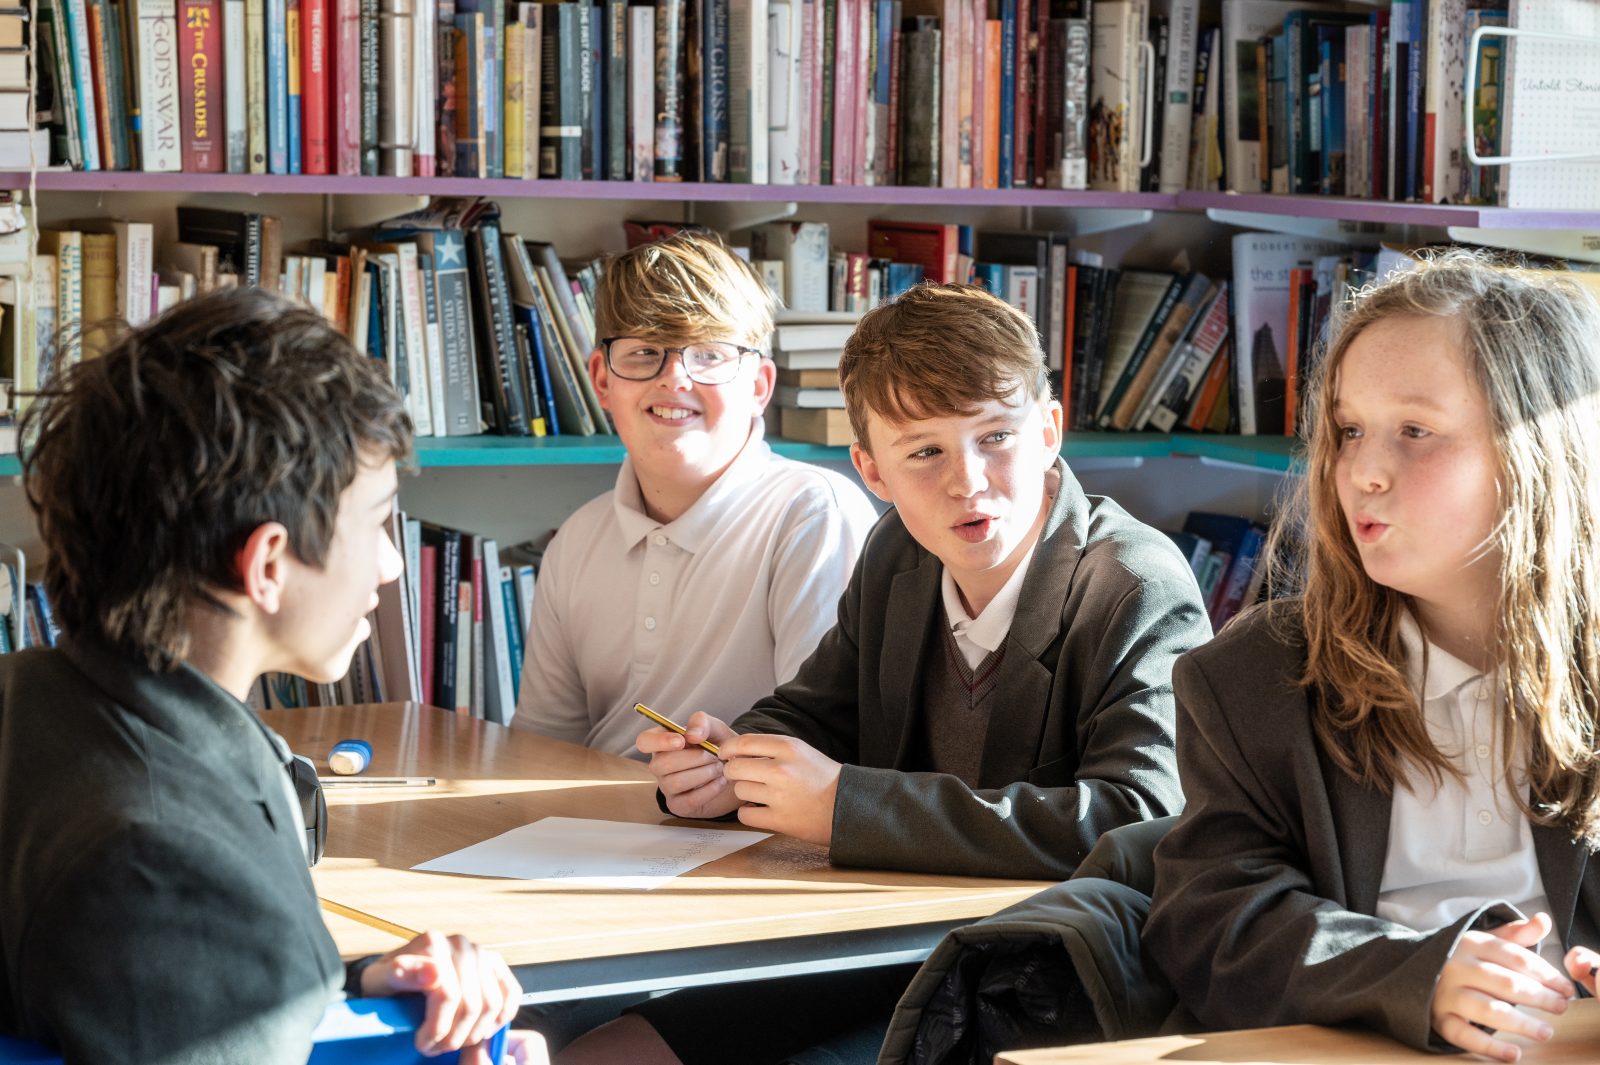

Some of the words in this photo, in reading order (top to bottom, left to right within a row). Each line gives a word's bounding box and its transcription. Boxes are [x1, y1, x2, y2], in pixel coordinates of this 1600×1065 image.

[312, 8, 321, 26] THE
[581, 7, 589, 24] THE
[1181, 6, 1193, 46] HOME
[153, 18, 172, 89] GOD'S
[193, 30, 205, 50] THE
[312, 28, 322, 73] CRUSADES
[362, 42, 370, 59] THE
[581, 26, 589, 48] FIRST
[362, 62, 370, 84] EAST
[371, 28, 379, 84] CRUSADE
[581, 51, 590, 92] CRUSADE
[1178, 50, 1191, 85] RULE
[192, 53, 208, 138] CRUSADES
[711, 48, 727, 121] CROSS
[157, 94, 174, 150] WAR
[248, 220, 258, 243] THE
[1252, 241, 1296, 252] ROBERT
[61, 244, 71, 266] Sir
[72, 245, 81, 271] THE
[407, 270, 417, 297] NEW
[454, 280, 463, 296] MY
[1251, 266, 1274, 282] the
[61, 269, 71, 321] Francis
[425, 269, 437, 322] DALLEK
[409, 299, 420, 330] DEAL
[444, 300, 456, 338] STUDS
[455, 299, 468, 351] AMERICAN
[485, 246, 498, 305] WALTER
[493, 312, 510, 389] CRONKITE
[447, 341, 460, 385] TERKEL
[460, 354, 473, 402] CENTURY
